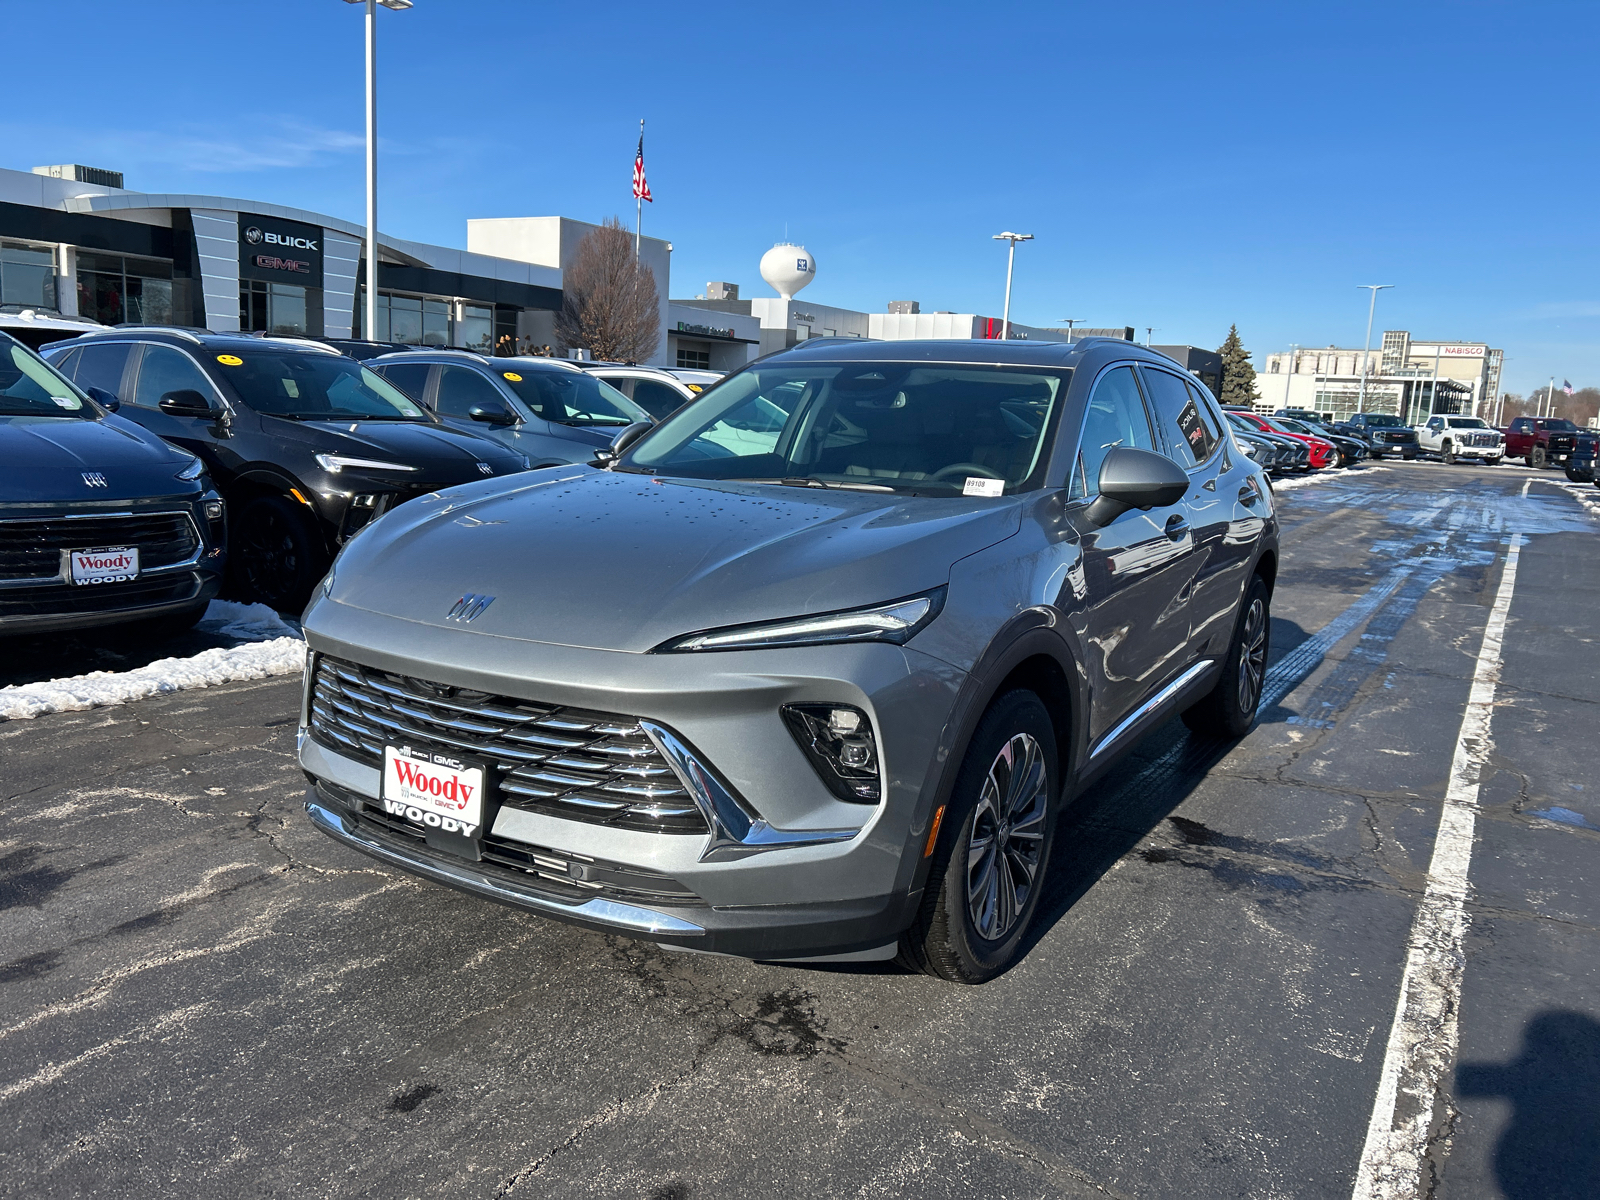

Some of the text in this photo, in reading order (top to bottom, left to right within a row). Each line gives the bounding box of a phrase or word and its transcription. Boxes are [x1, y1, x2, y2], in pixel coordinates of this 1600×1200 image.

[264, 232, 318, 251] BUICK
[256, 254, 310, 274] GMC
[1444, 347, 1483, 355] NABISCO
[966, 479, 986, 488] 89108
[77, 554, 133, 570] Woody
[75, 573, 138, 586] WOODY
[433, 754, 461, 768] GMC
[393, 758, 474, 810] Woody
[384, 799, 477, 837] WOODY
